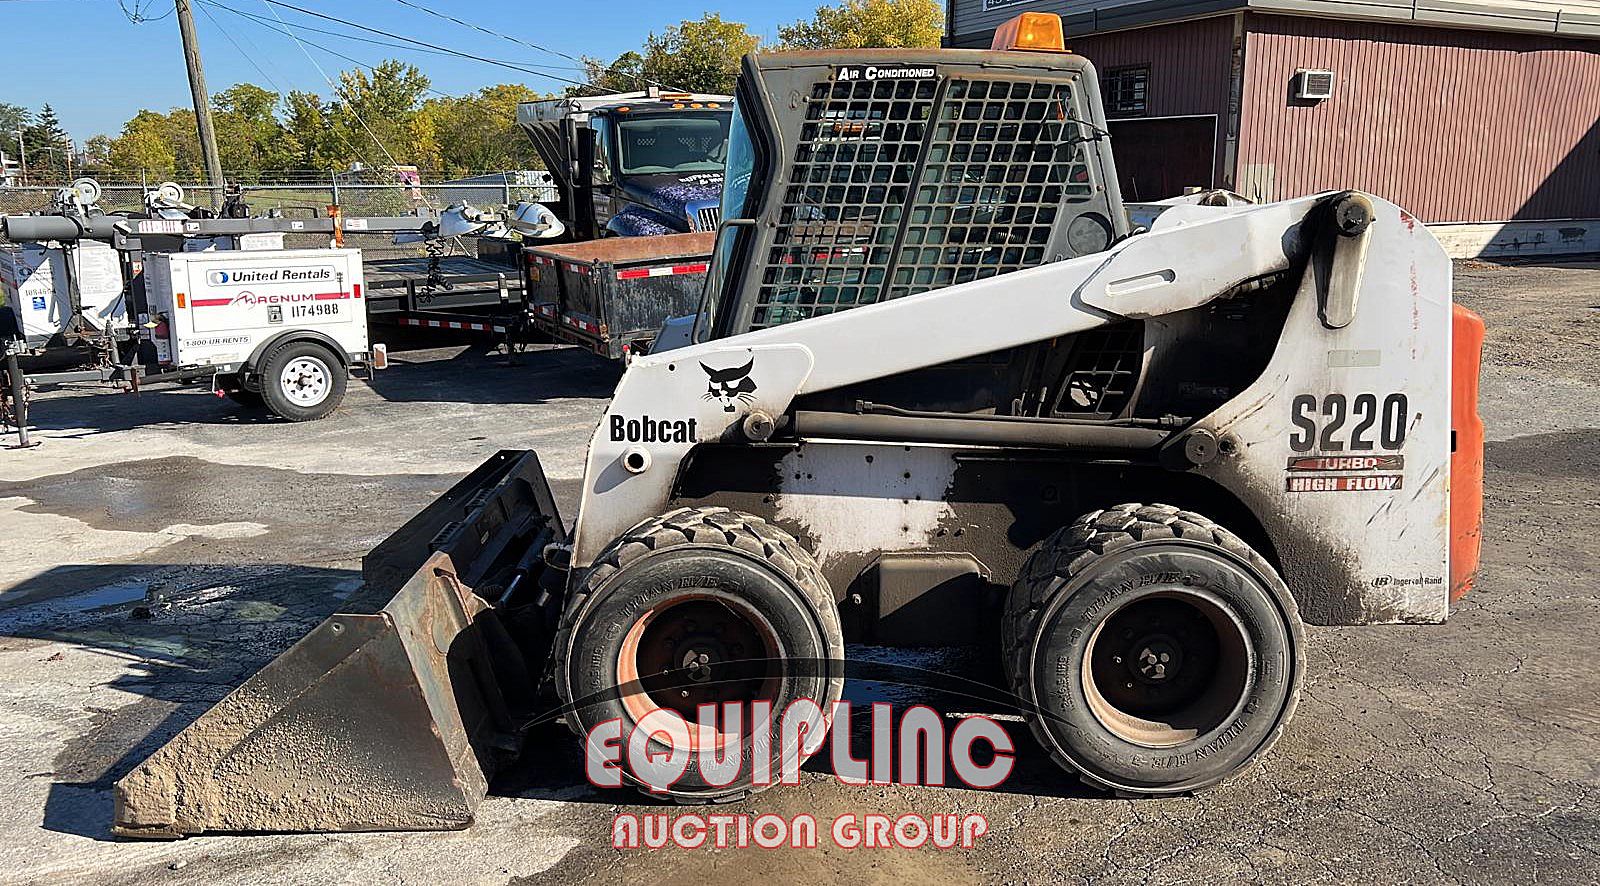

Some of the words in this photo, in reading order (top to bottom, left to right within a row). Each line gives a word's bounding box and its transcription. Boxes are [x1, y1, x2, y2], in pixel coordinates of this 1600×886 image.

[837, 67, 860, 80] AIR
[865, 66, 935, 80] CONDITIONED
[232, 270, 278, 282] United
[282, 268, 331, 280] Rentals
[231, 291, 314, 307] MAGNUM
[291, 303, 339, 318] 1174988
[609, 414, 698, 443] Bobcat
[1289, 392, 1408, 452] S220
[1317, 457, 1378, 470] TURBO
[1291, 477, 1338, 491] HIGH
[1346, 476, 1399, 490] FLOW
[1424, 576, 1443, 585] Rand
